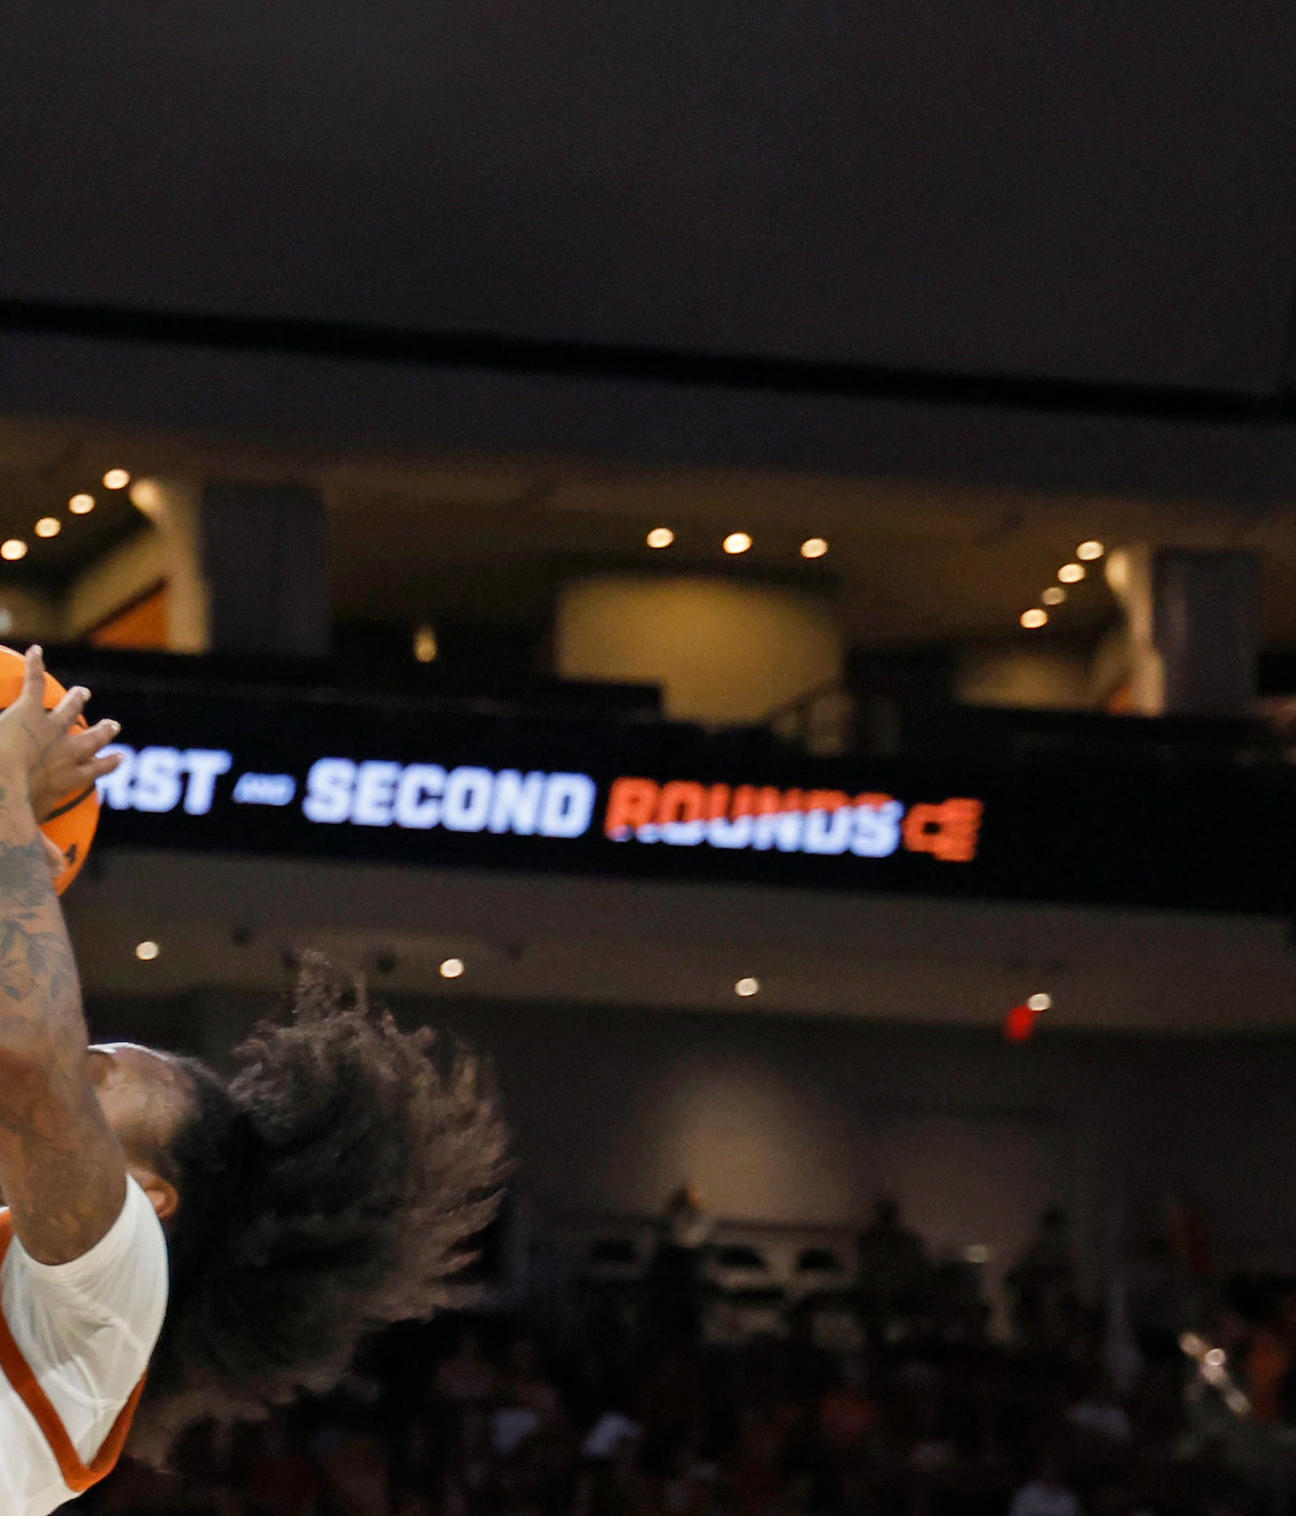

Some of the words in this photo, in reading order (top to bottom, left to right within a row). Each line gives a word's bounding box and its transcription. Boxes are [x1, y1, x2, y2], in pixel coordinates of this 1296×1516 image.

[94, 743, 233, 816] RST
[303, 757, 596, 839] SECOND
[605, 776, 905, 859] ROUNDS
